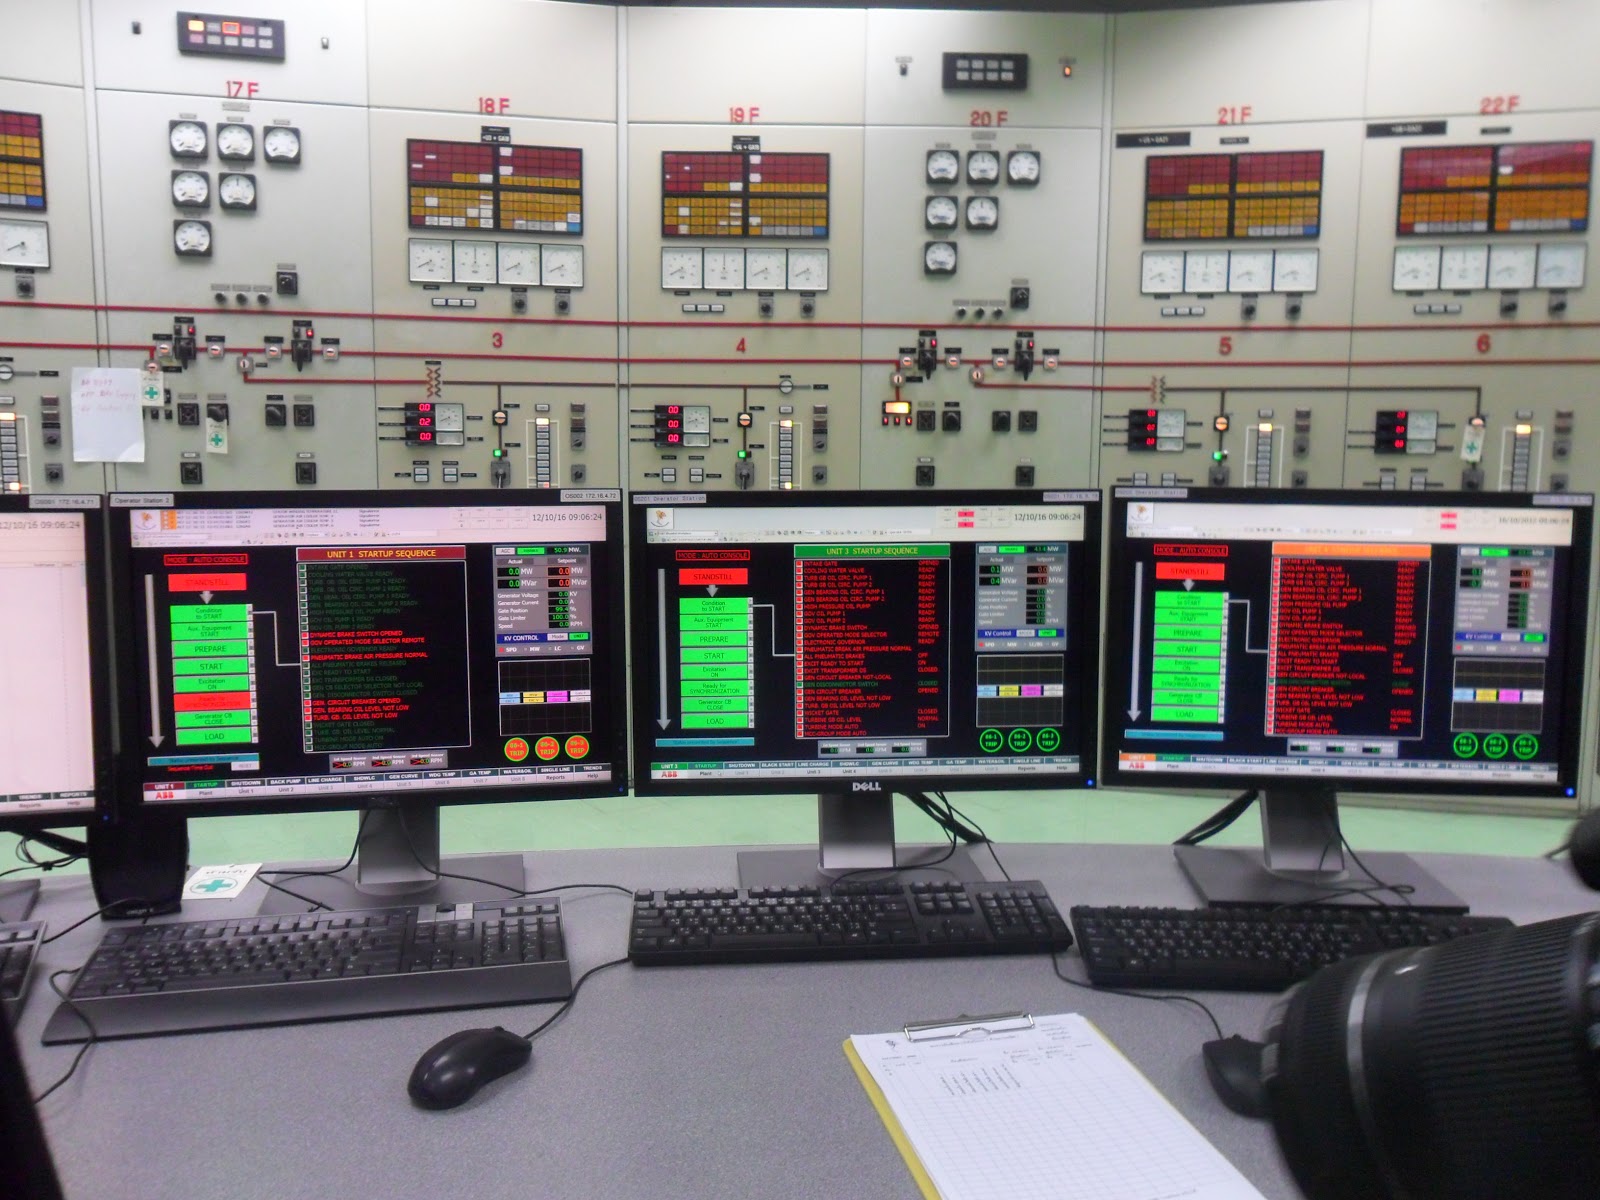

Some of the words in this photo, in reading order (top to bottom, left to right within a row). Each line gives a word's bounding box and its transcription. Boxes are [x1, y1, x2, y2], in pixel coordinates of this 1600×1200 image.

[226, 80, 243, 98] 17
[247, 81, 259, 99] F
[479, 97, 495, 115] 18
[499, 97, 510, 115] F
[1480, 96, 1503, 115] 22
[1509, 95, 1519, 113] F
[730, 107, 744, 123] 19
[750, 107, 760, 124] F
[970, 110, 992, 127] 20
[997, 110, 1008, 128] F
[1218, 107, 1236, 125] 21
[1241, 106, 1252, 124] F
[492, 333, 503, 348] 3
[736, 337, 746, 353] 4
[1219, 336, 1232, 356] 5
[1477, 334, 1491, 353] 6
[532, 514, 567, 522] 12/10/16
[568, 513, 602, 521] 09:06:24
[1048, 513, 1081, 521] 09:06:24
[852, 782, 882, 792] DELL
